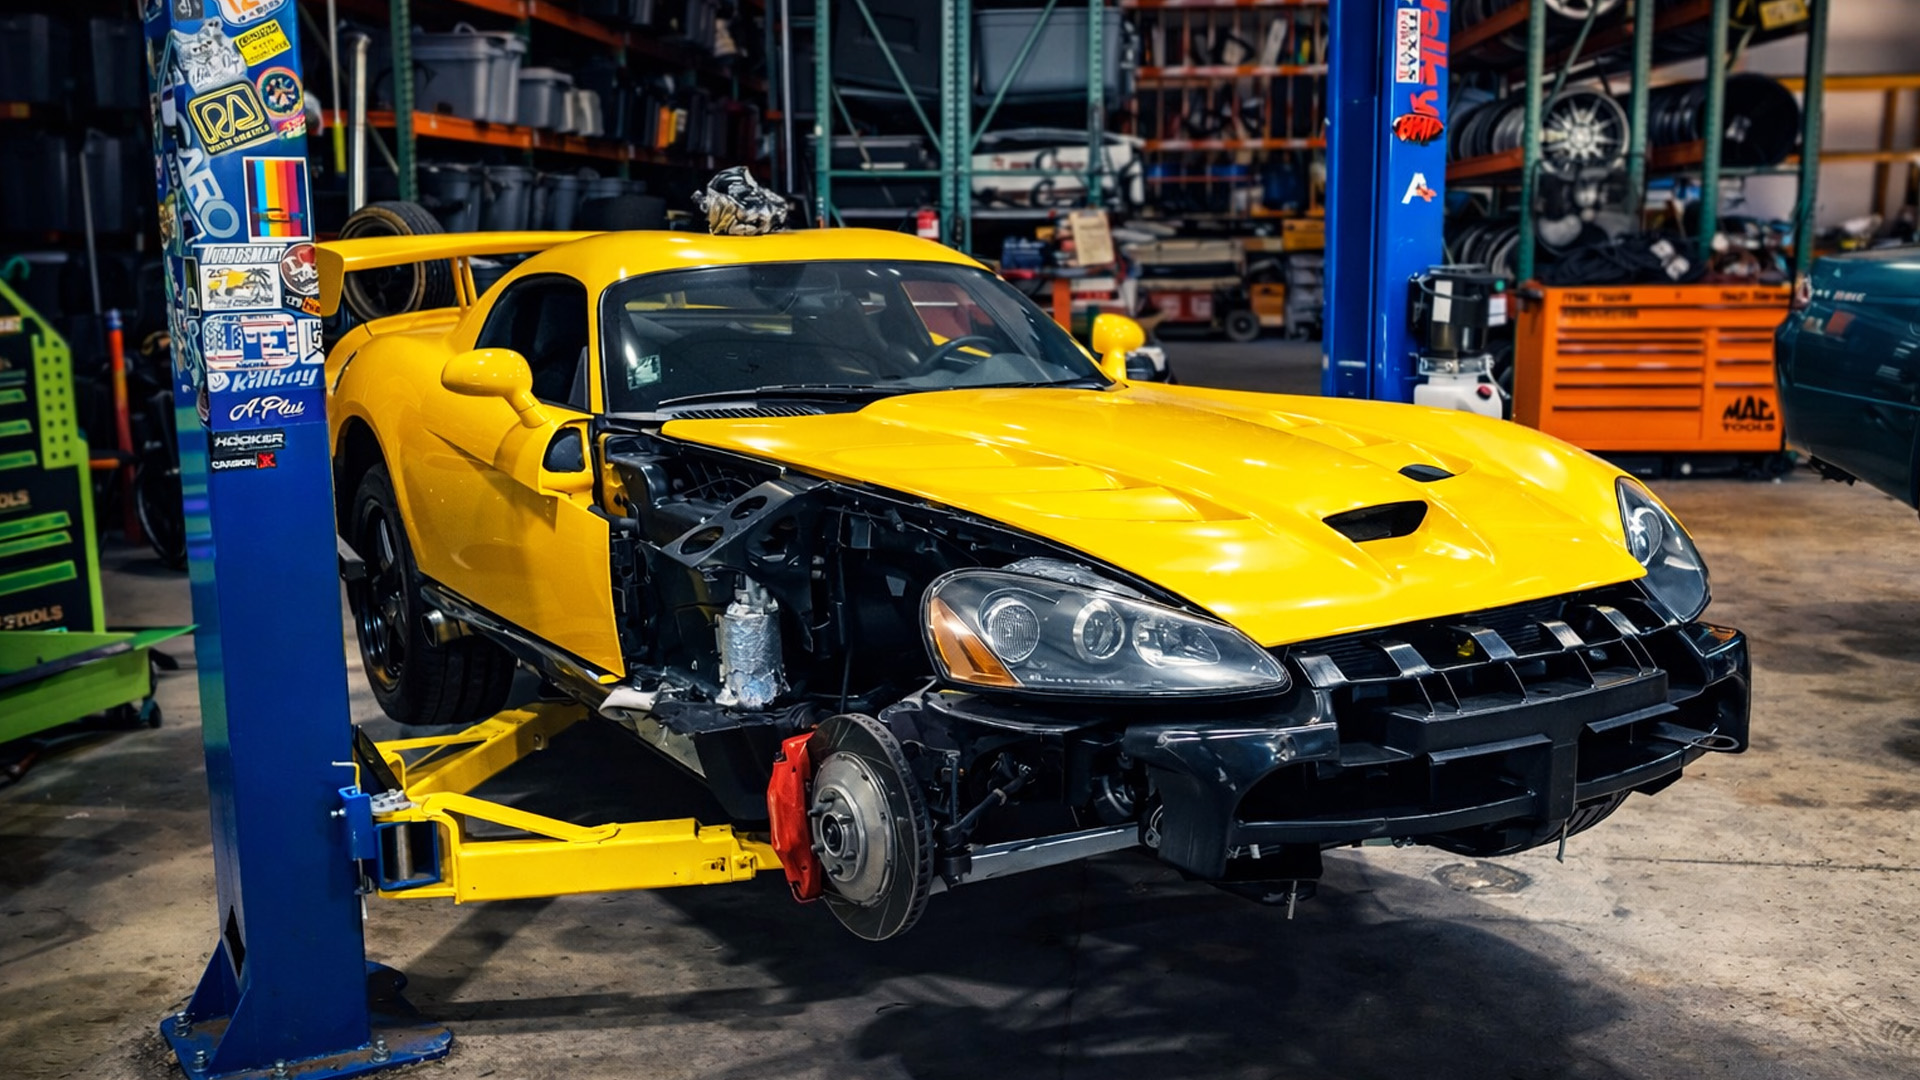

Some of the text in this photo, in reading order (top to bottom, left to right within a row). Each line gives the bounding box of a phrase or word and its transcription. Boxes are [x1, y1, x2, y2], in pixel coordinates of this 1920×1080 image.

[229, 396, 306, 421] A-Plus
[1722, 395, 1775, 421] MAC
[1722, 422, 1775, 432] TOOLS
